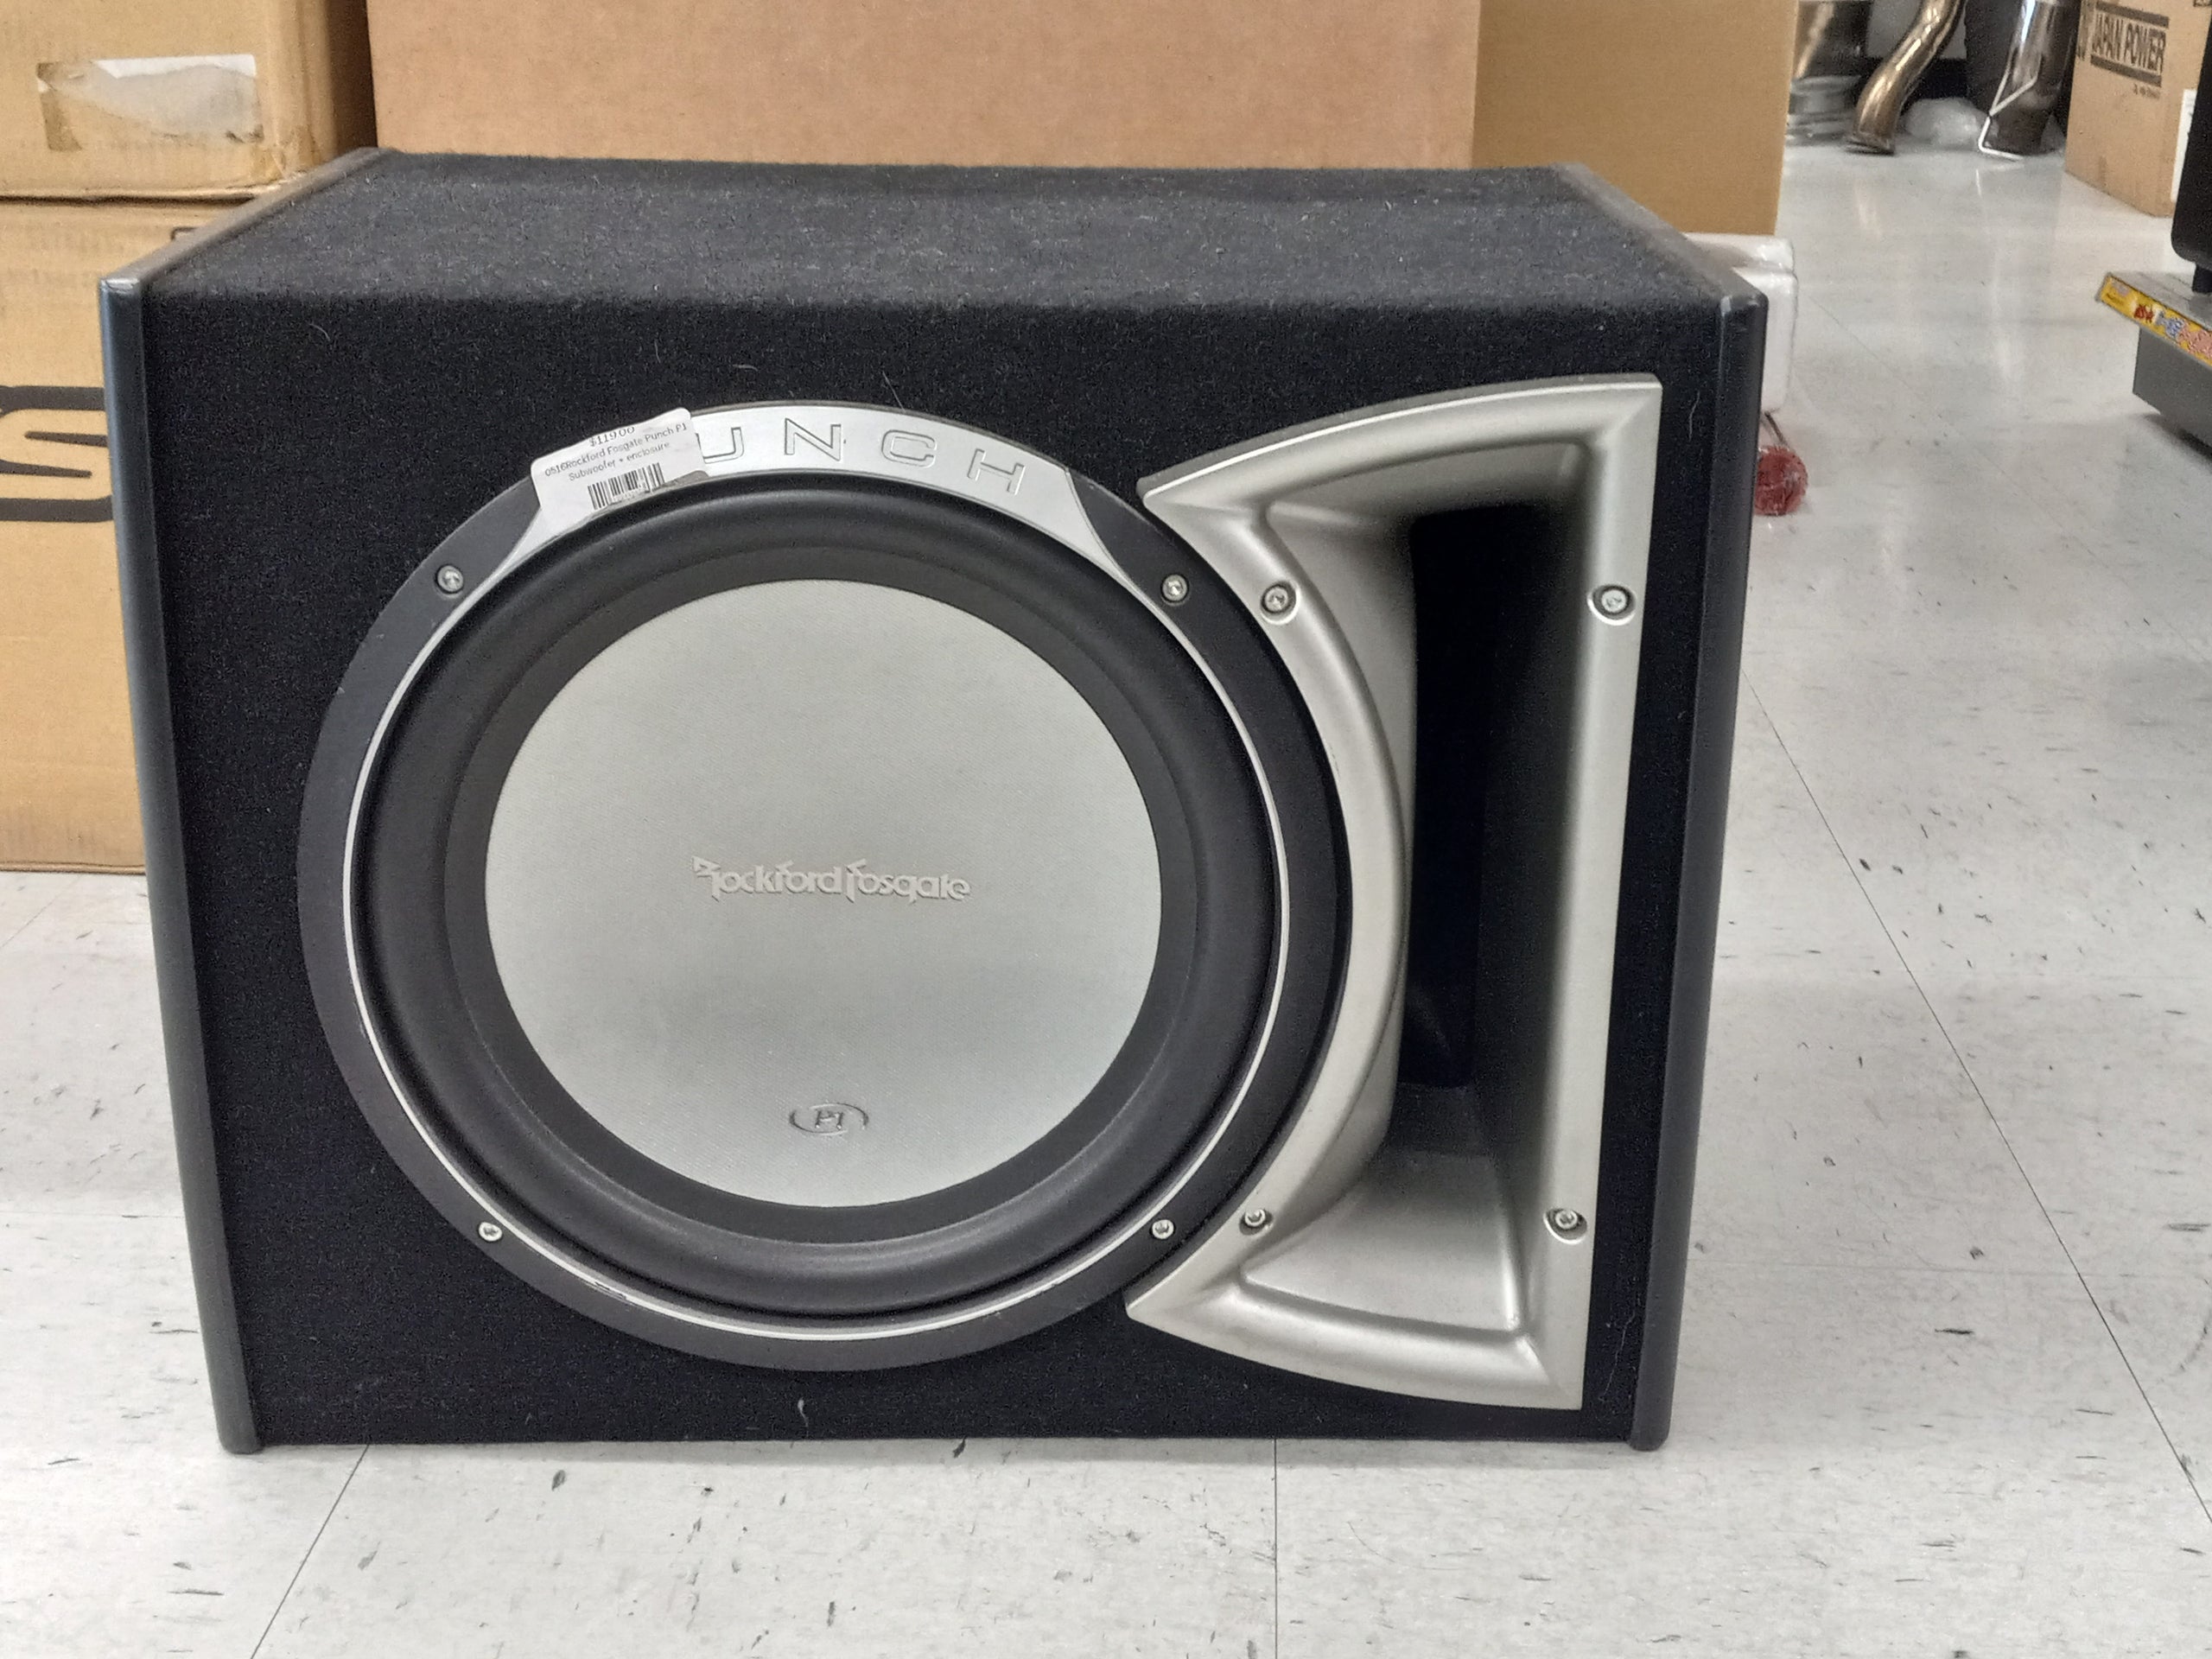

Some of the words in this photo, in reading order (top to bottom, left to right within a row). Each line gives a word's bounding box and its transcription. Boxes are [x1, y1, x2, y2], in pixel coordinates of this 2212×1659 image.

[2123, 22, 2166, 73] POWER
[645, 428, 675, 443] Punch
[695, 417, 1027, 497] UNCH
[569, 460, 616, 481] Subwoofer
[626, 442, 671, 461] enclosure
